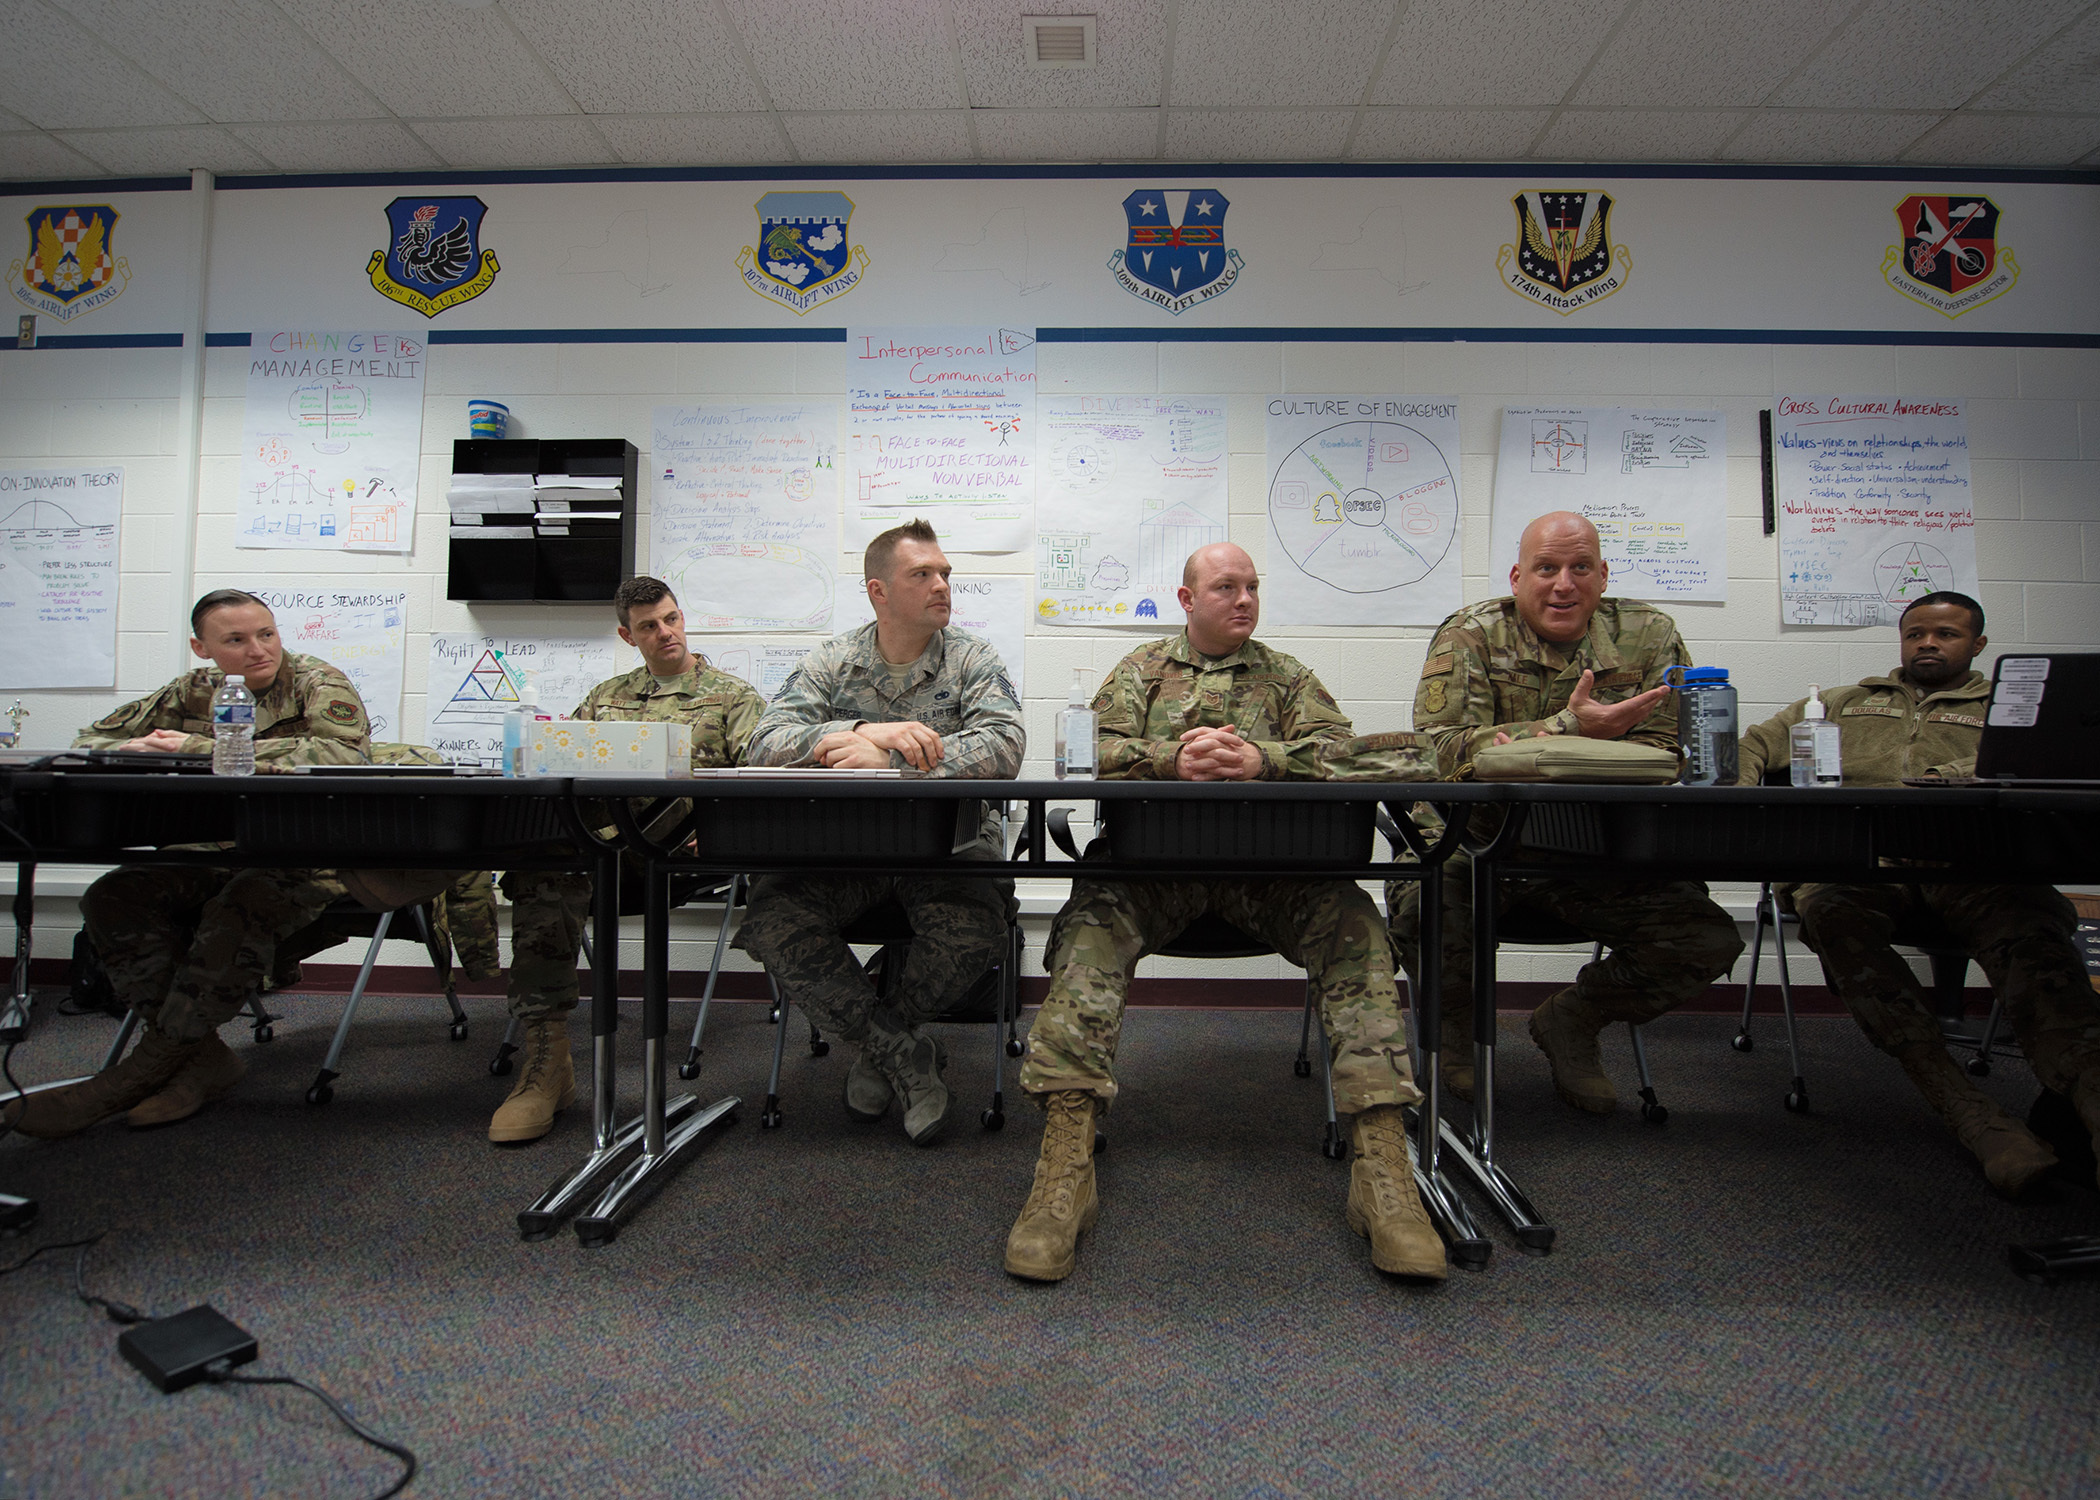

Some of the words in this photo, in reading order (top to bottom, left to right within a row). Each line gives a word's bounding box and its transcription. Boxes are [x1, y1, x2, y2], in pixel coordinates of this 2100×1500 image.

[407, 293, 458, 312] RESCUE
[459, 272, 493, 299] WING
[770, 284, 819, 310] AIRLIFT
[821, 271, 859, 296] WING
[1116, 267, 1139, 293] 109th
[1140, 287, 1195, 311] AIRLIFT
[1200, 269, 1236, 299] WING
[1510, 273, 1541, 299] 174th
[1541, 292, 1586, 309] Attack
[1584, 277, 1618, 299] Wing
[1892, 275, 1929, 300] EASTERN
[1928, 296, 1944, 308] AIR
[1943, 291, 1981, 310] DEFENSE
[1981, 274, 2008, 298] SECTOR
[38, 298, 81, 320] AIRLIFT
[83, 286, 118, 308] WING
[269, 331, 389, 353] CHANGE
[858, 335, 994, 360] Interpersonal
[250, 359, 420, 378] MANAGEMENT
[909, 362, 1036, 384] Communication
[942, 388, 1005, 398] Multidirectional
[1268, 400, 1350, 416] CULTURE
[1357, 401, 1381, 416] OF
[1386, 401, 1458, 420] ENGAGEMENT
[1778, 396, 1819, 416] CROSS
[1828, 397, 1889, 415] CULTURAL
[1892, 399, 1959, 416] AWARENESS
[673, 406, 730, 427] Continuous
[660, 434, 695, 451] Systems
[724, 430, 753, 450] Thinking
[888, 435, 967, 449] FACE-TO-FACE
[1847, 440, 1858, 448] on
[1924, 436, 1940, 448] the
[1820, 450, 1837, 459] and
[1866, 462, 1892, 471] status
[1904, 458, 1951, 471] Achievement
[82, 473, 120, 487] THEORY
[1398, 478, 1446, 501] BLOGGING
[1811, 489, 1846, 499] Tradition
[1900, 488, 1932, 504] Security
[670, 503, 708, 515] Decision
[712, 502, 742, 517] Analysis
[1865, 506, 1882, 518] way
[1884, 509, 1919, 518] someones
[1924, 510, 1944, 518] sees
[1949, 507, 1972, 519] world
[700, 516, 734, 530] Statement
[755, 518, 791, 529] Determine
[1811, 514, 1836, 524] events
[1850, 515, 1877, 524] relation
[1913, 516, 1944, 532] religious
[771, 530, 800, 544] Analysis
[1338, 539, 1382, 558] tumblr
[1146, 585, 1179, 593] DIVE
[331, 592, 406, 607] STEWARDSHIP
[354, 613, 376, 629] IT
[295, 627, 340, 641] WARFARE
[332, 644, 387, 660] ENERGY
[433, 638, 478, 665] RIGHT
[481, 637, 495, 648] TO
[505, 641, 537, 656] LEAD
[1149, 669, 1184, 679] VANOVER
[931, 709, 944, 719] AIR
[1851, 707, 1892, 715] DOUGLAS
[1944, 713, 1958, 721] AIR
[1960, 714, 1985, 727] FORC
[432, 738, 481, 751] SKINNERS
